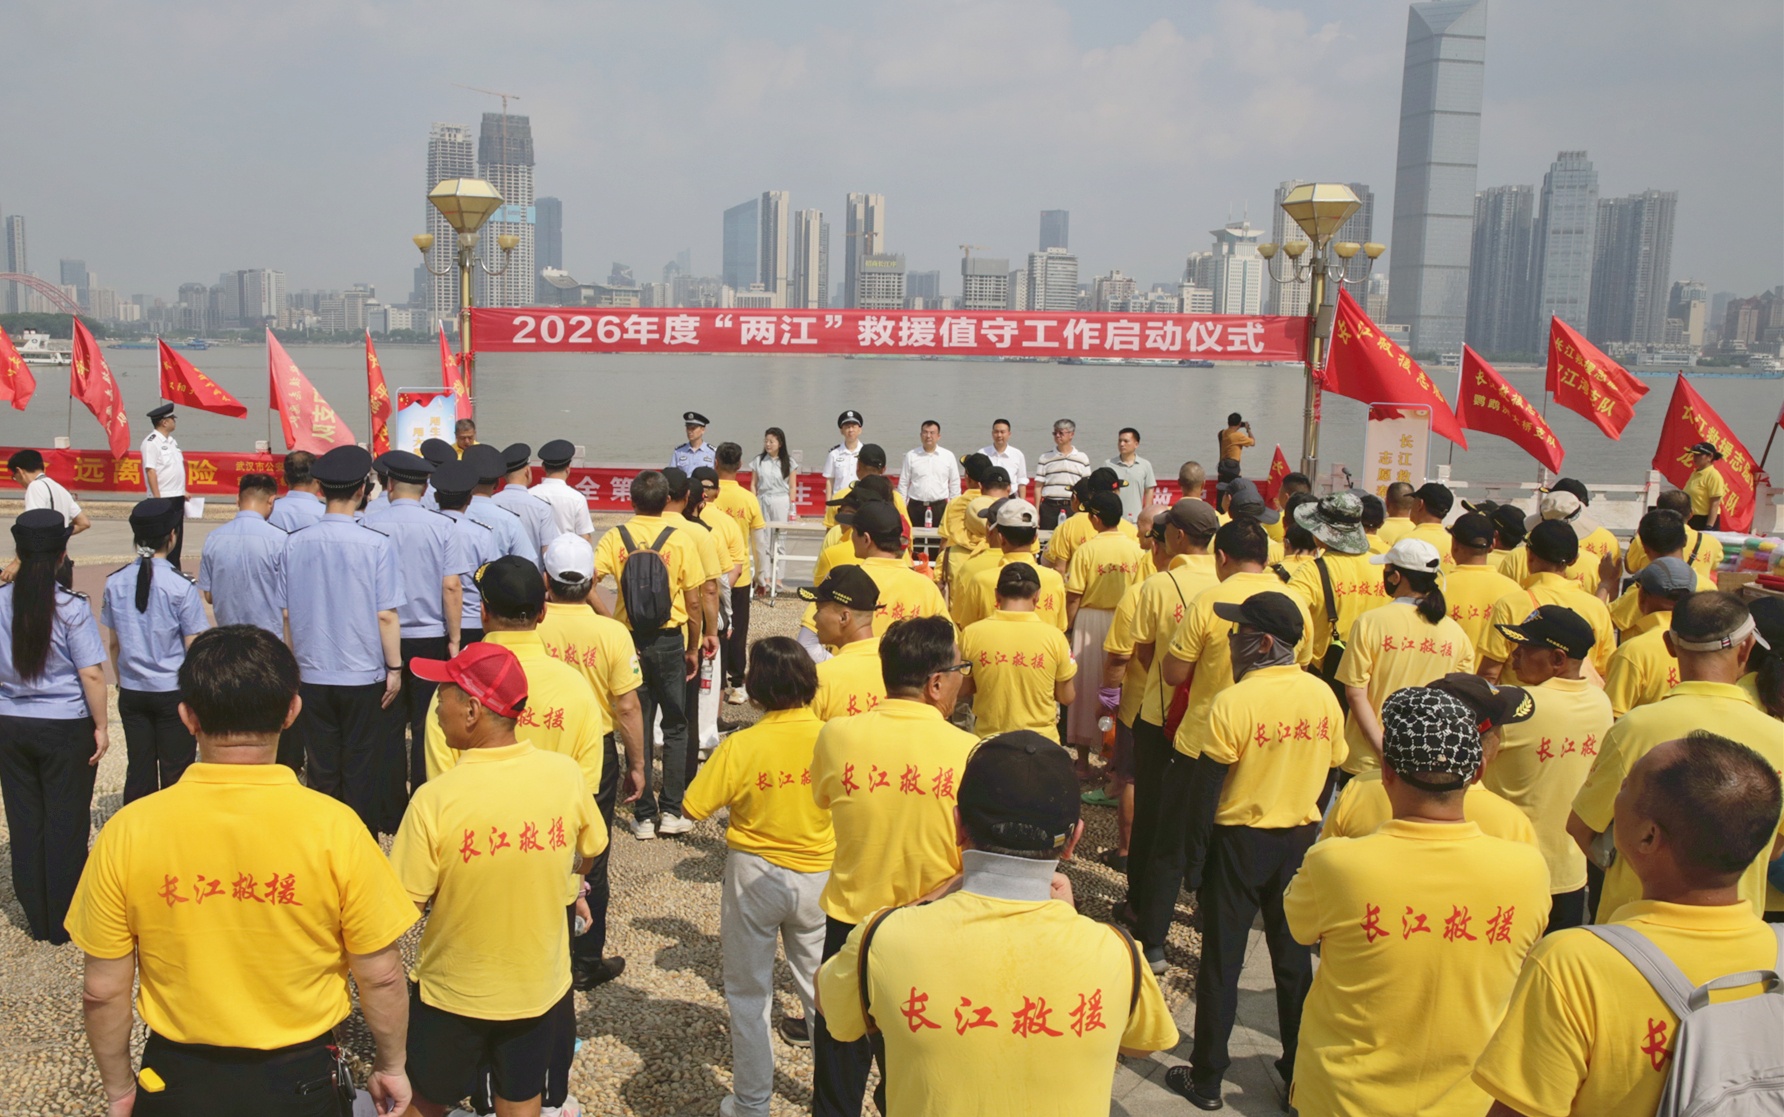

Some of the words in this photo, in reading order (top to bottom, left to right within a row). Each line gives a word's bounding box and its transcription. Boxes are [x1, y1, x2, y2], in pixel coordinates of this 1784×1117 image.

[978, 651, 1046, 669] 长江救援
[1381, 635, 1453, 658] 长江救援
[846, 692, 888, 716] 长江
[1254, 716, 1330, 748] 长江救援
[842, 761, 955, 800] 长江救援
[458, 816, 568, 864] 长江救援
[157, 872, 303, 908] 长江救援
[1360, 902, 1515, 945] 长江救援
[899, 986, 1107, 1039] 长江救援
